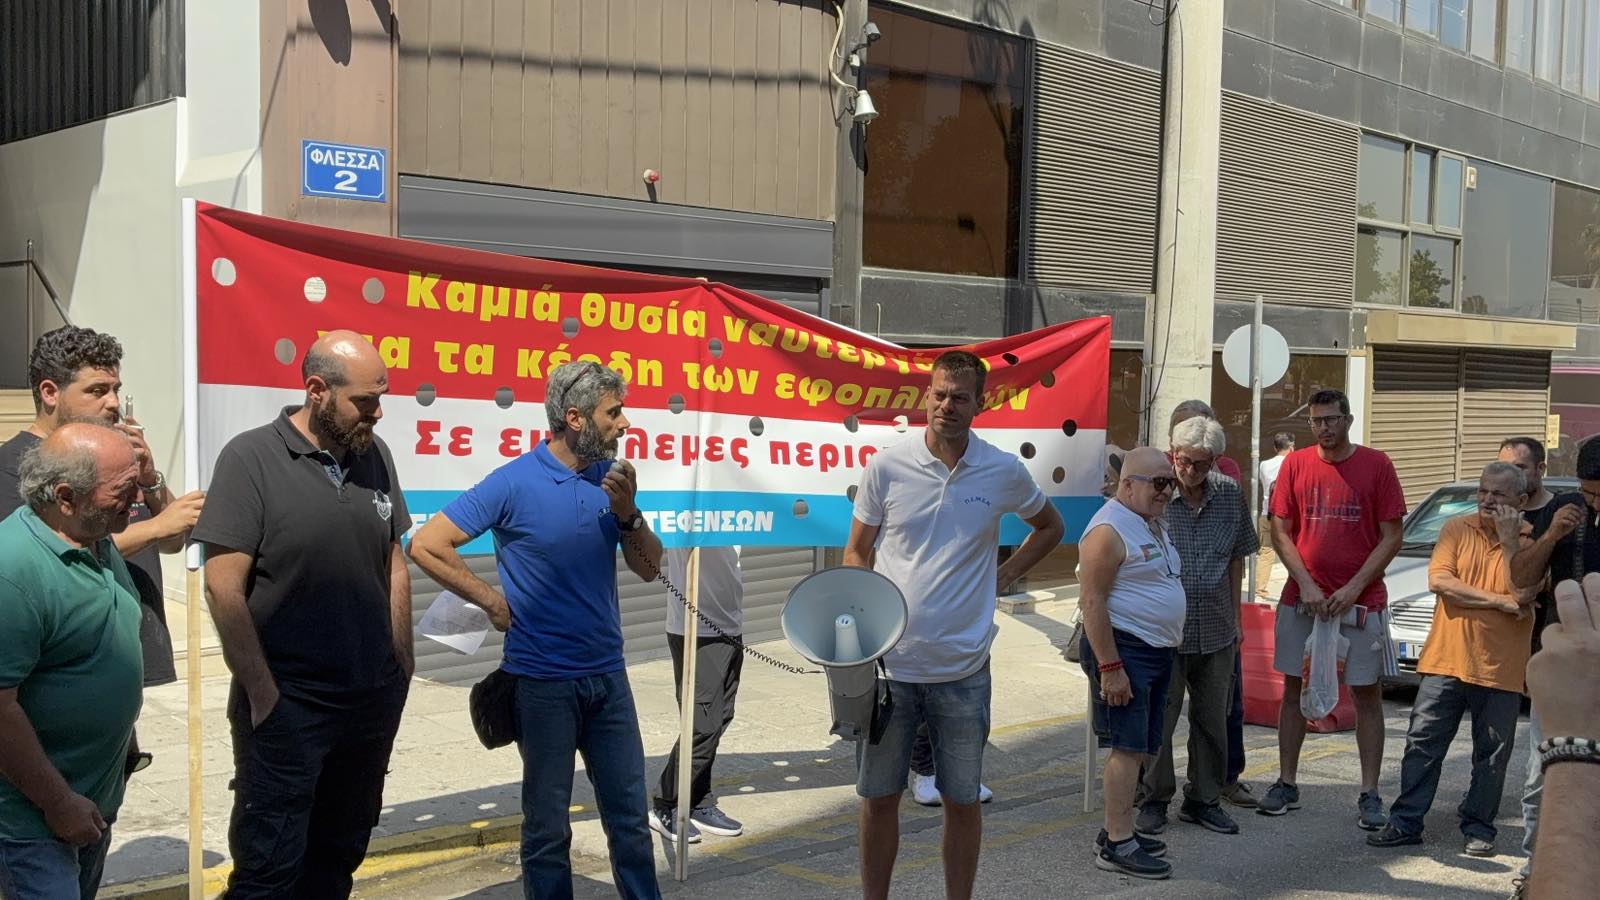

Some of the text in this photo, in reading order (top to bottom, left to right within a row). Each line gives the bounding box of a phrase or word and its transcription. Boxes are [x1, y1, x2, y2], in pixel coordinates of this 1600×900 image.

[310, 148, 380, 171] ΦΛΕΣΣΑ
[334, 170, 358, 192] 2
[406, 271, 561, 322] Καμιά
[580, 293, 706, 338] θυσία
[434, 341, 495, 375] τα
[682, 362, 760, 395] των
[415, 420, 473, 457] Σε
[769, 440, 878, 473] περιο
[641, 509, 774, 533] ΤΕΦΕΝΣΩΝ
